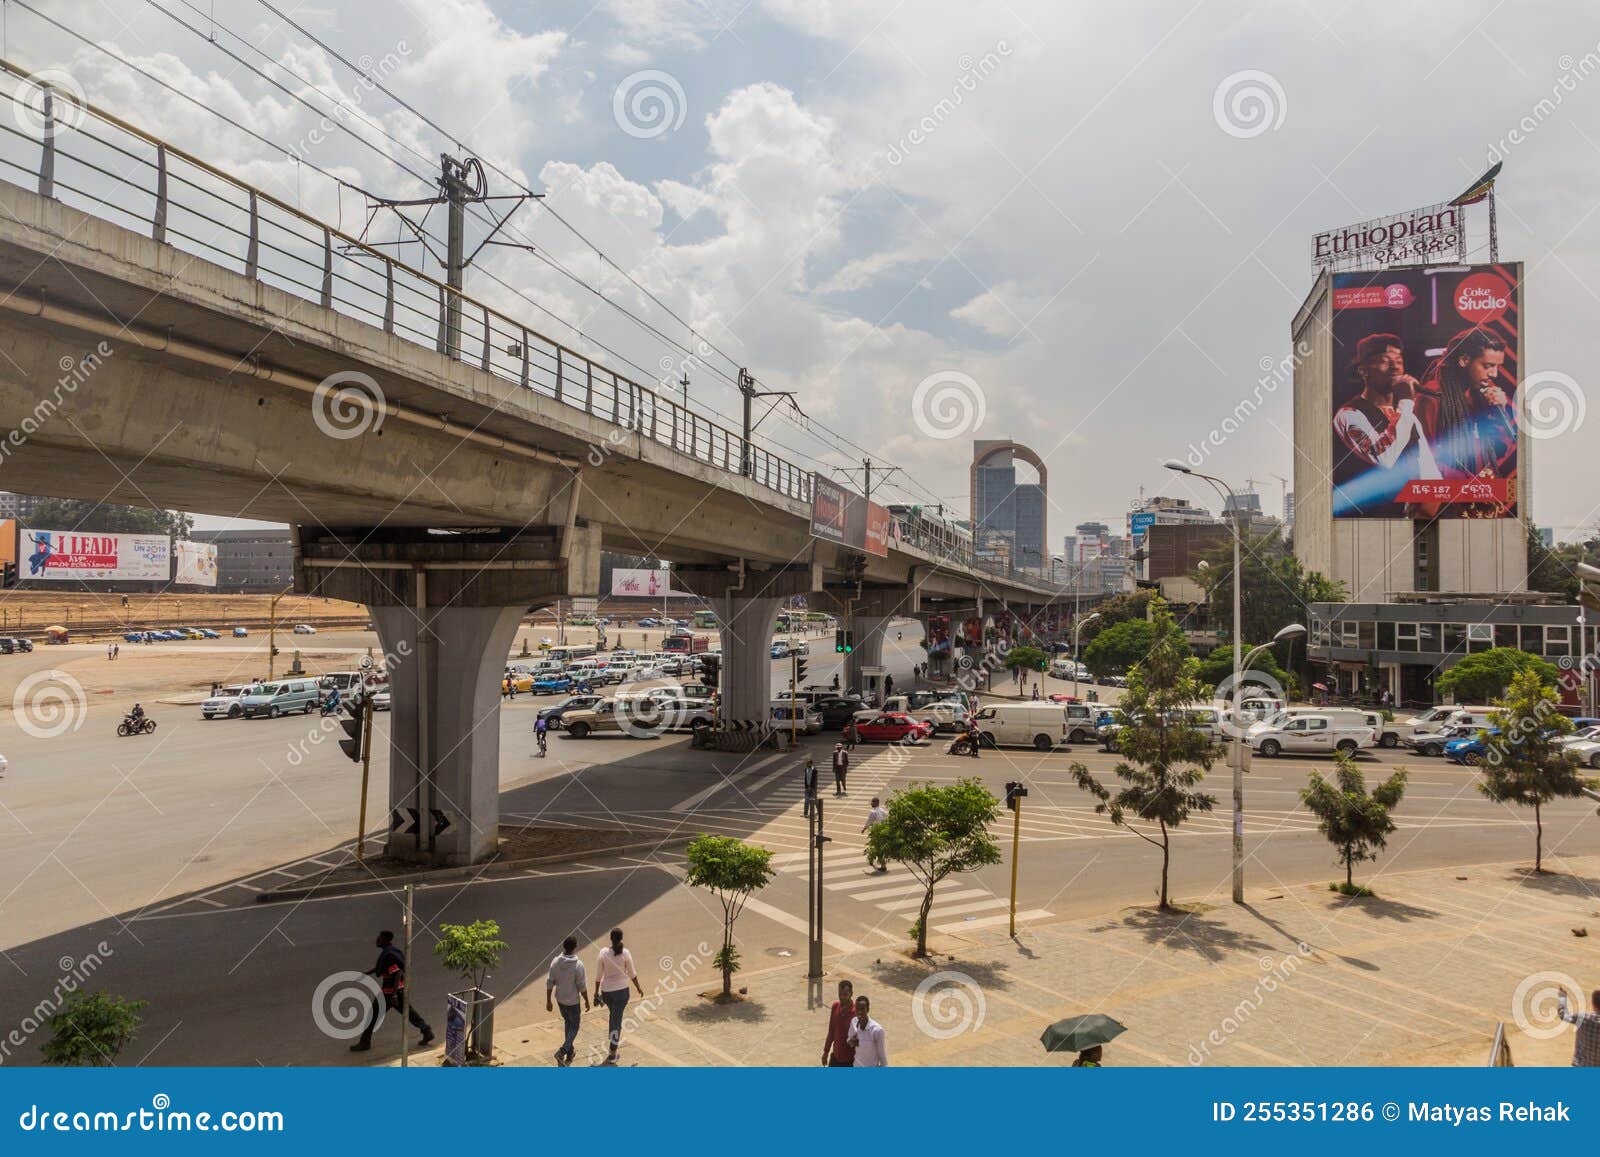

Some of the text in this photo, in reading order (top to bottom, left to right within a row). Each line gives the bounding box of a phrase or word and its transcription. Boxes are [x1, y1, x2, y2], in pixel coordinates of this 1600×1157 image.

[1314, 209, 1457, 258] Ethiopian
[1463, 287, 1490, 297] Coke
[1458, 295, 1507, 311] Studio
[1433, 485, 1451, 494] 187
[58, 535, 118, 556] I LEAD!
